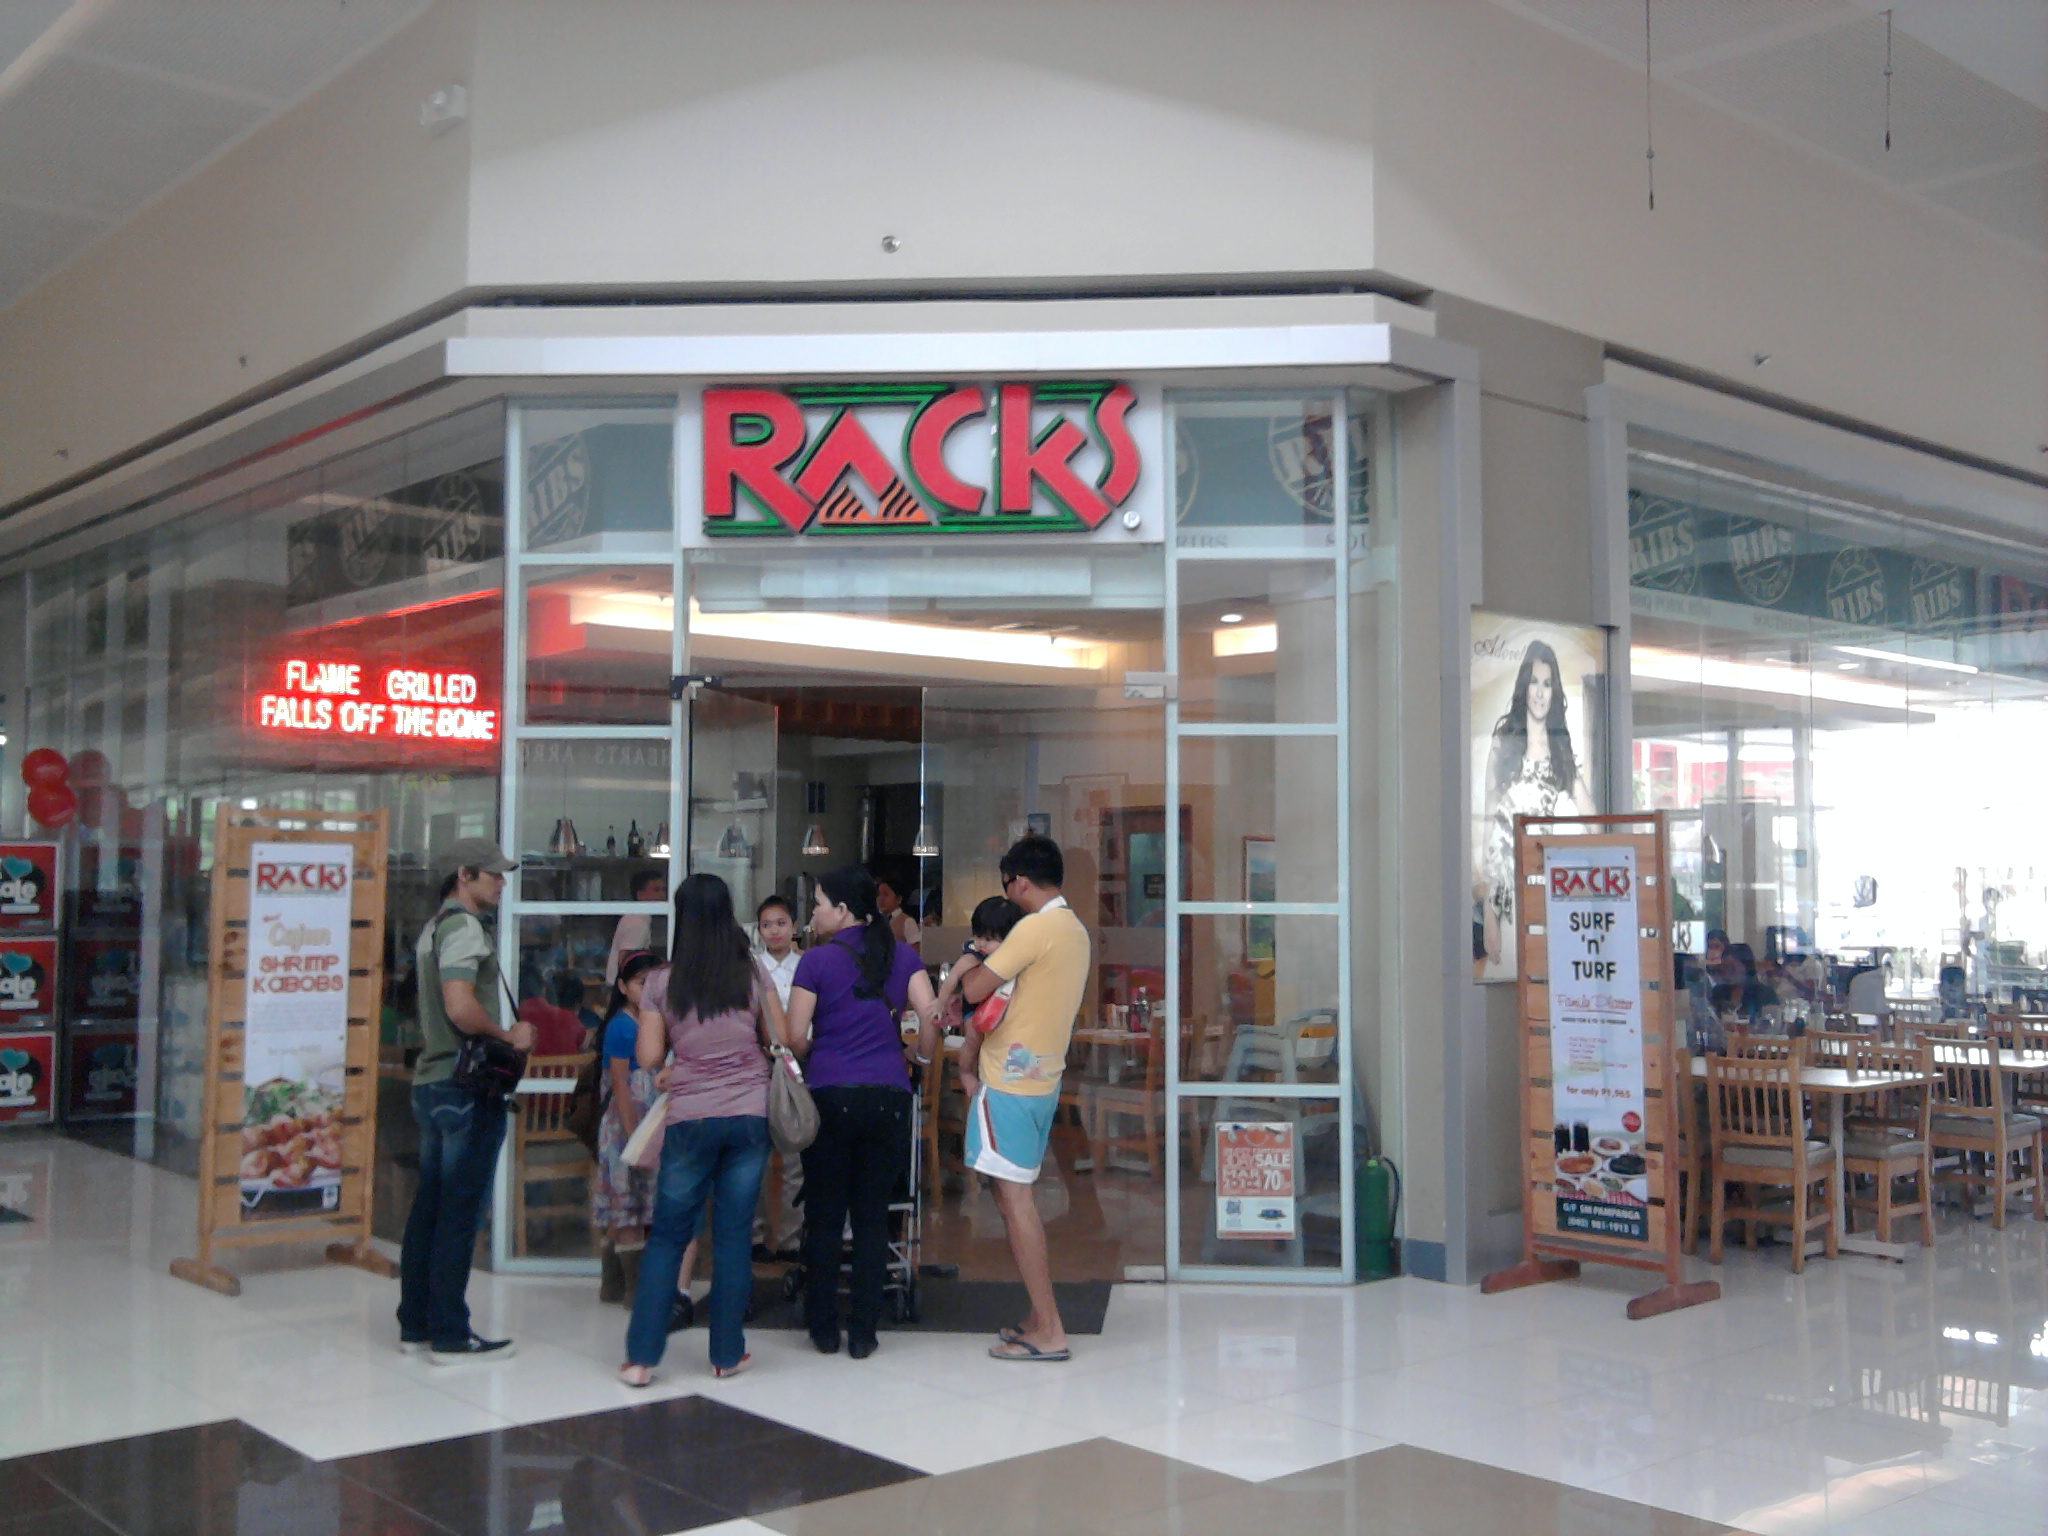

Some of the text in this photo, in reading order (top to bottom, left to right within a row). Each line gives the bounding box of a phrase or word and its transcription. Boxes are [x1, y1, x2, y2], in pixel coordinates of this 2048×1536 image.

[702, 383, 1141, 532] RACKS
[1831, 579, 1885, 622] RIBS
[1911, 577, 1962, 623] RIBS
[286, 660, 477, 704] FLAME GRILLED
[260, 695, 496, 740] FALLS OFF THE BONE
[257, 862, 348, 893] RACKS
[1551, 867, 1631, 896] RACKS
[1569, 911, 1615, 932] SURF
[260, 955, 339, 973] SHRIMP
[1571, 961, 1616, 981] TURF
[1254, 1153, 1291, 1168] SALE
[1263, 1168, 1281, 1191] 70
